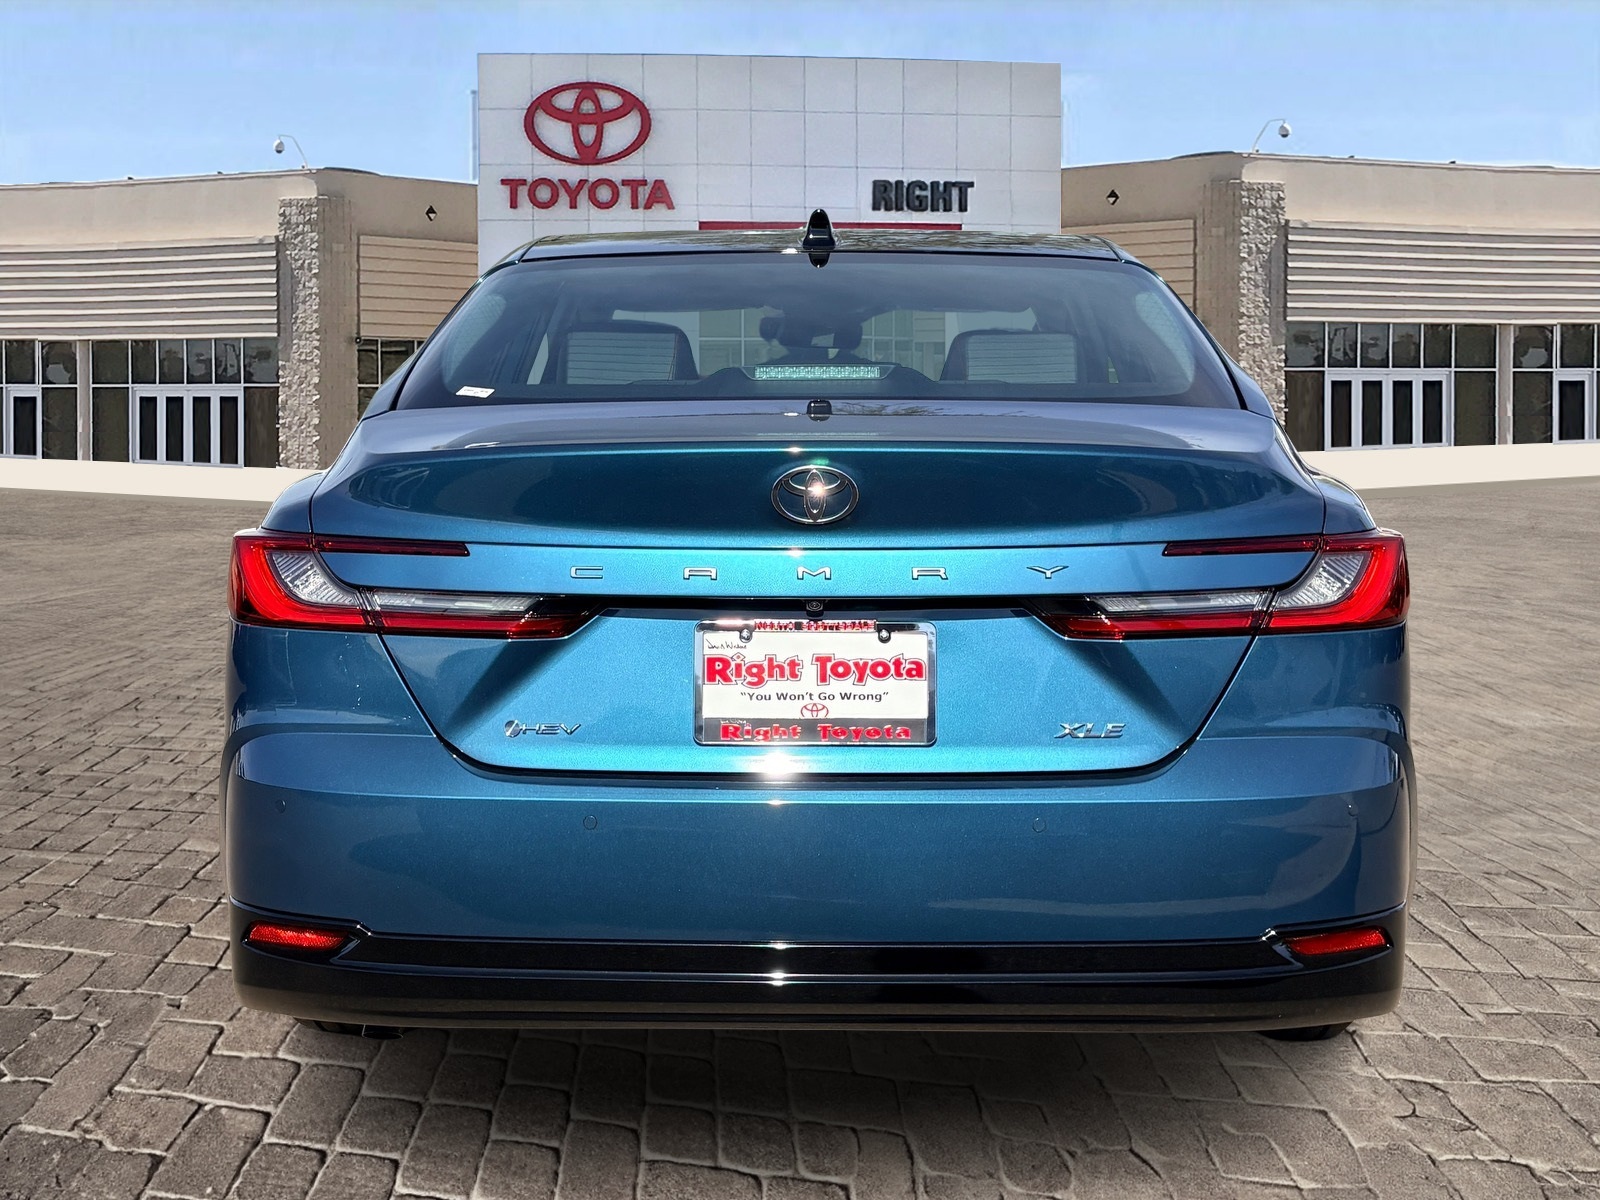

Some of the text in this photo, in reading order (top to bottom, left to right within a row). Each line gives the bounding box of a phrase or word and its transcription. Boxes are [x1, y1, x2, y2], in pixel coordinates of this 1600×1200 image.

[500, 179, 675, 209] TOYOTA
[872, 180, 975, 212] RIGHT
[570, 565, 1069, 581] CAMRY
[703, 652, 927, 688] Right Toyota
[740, 691, 889, 703] "You Won't Go Wrong"
[521, 723, 582, 736] HEV
[720, 723, 912, 742] Right Toyota
[1054, 722, 1126, 738] XLE
